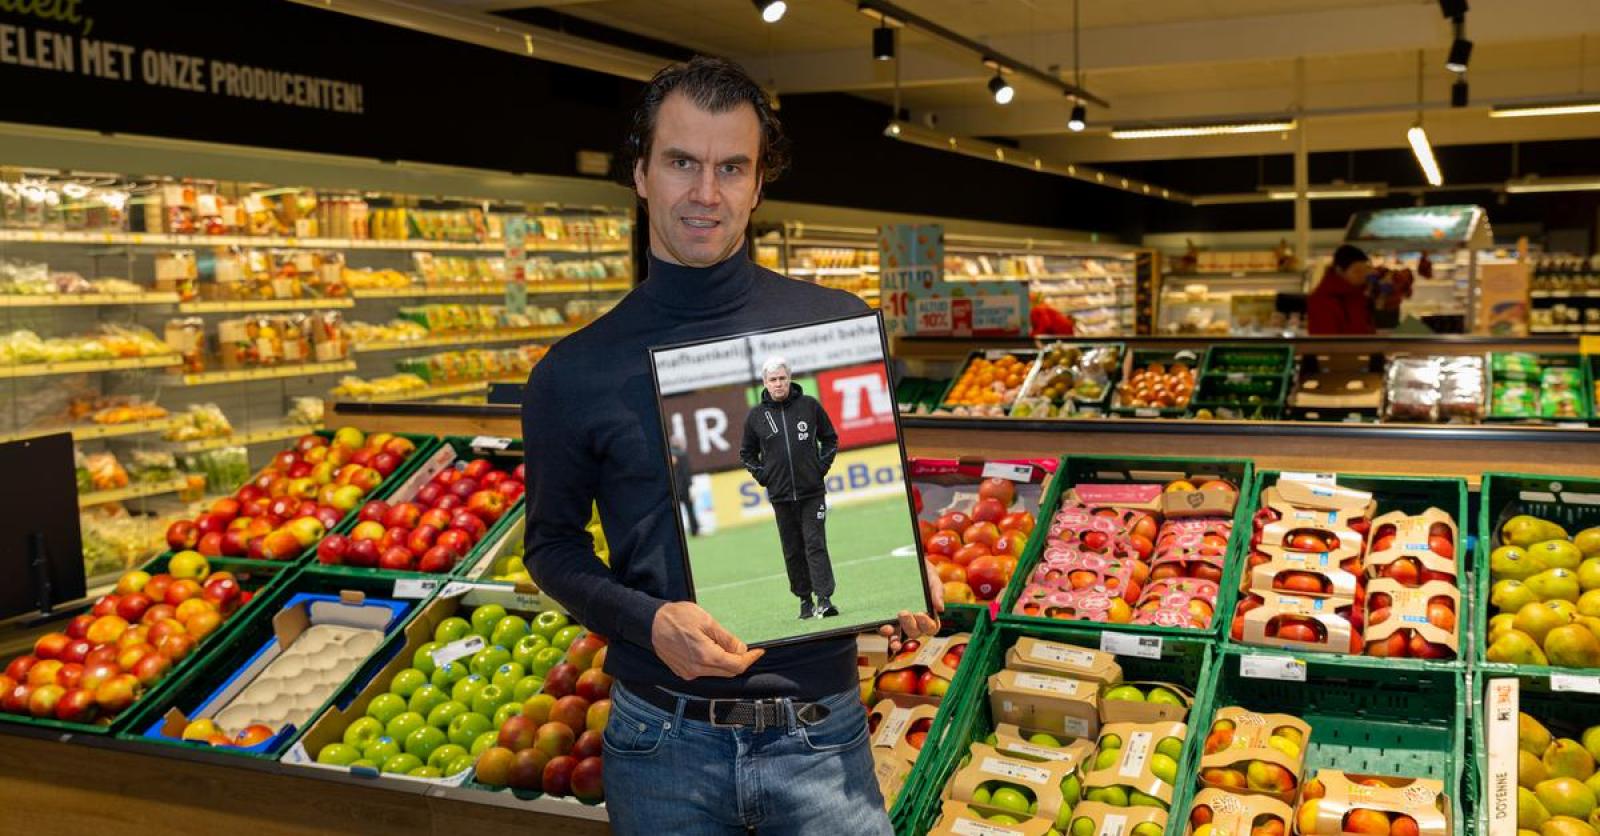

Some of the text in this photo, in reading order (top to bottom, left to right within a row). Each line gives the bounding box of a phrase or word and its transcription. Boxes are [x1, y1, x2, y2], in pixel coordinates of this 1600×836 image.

[0, 23, 365, 114] ELEN MET ONZE PRODUCENTEN!
[1496, 771, 1508, 820] DOYENNE
